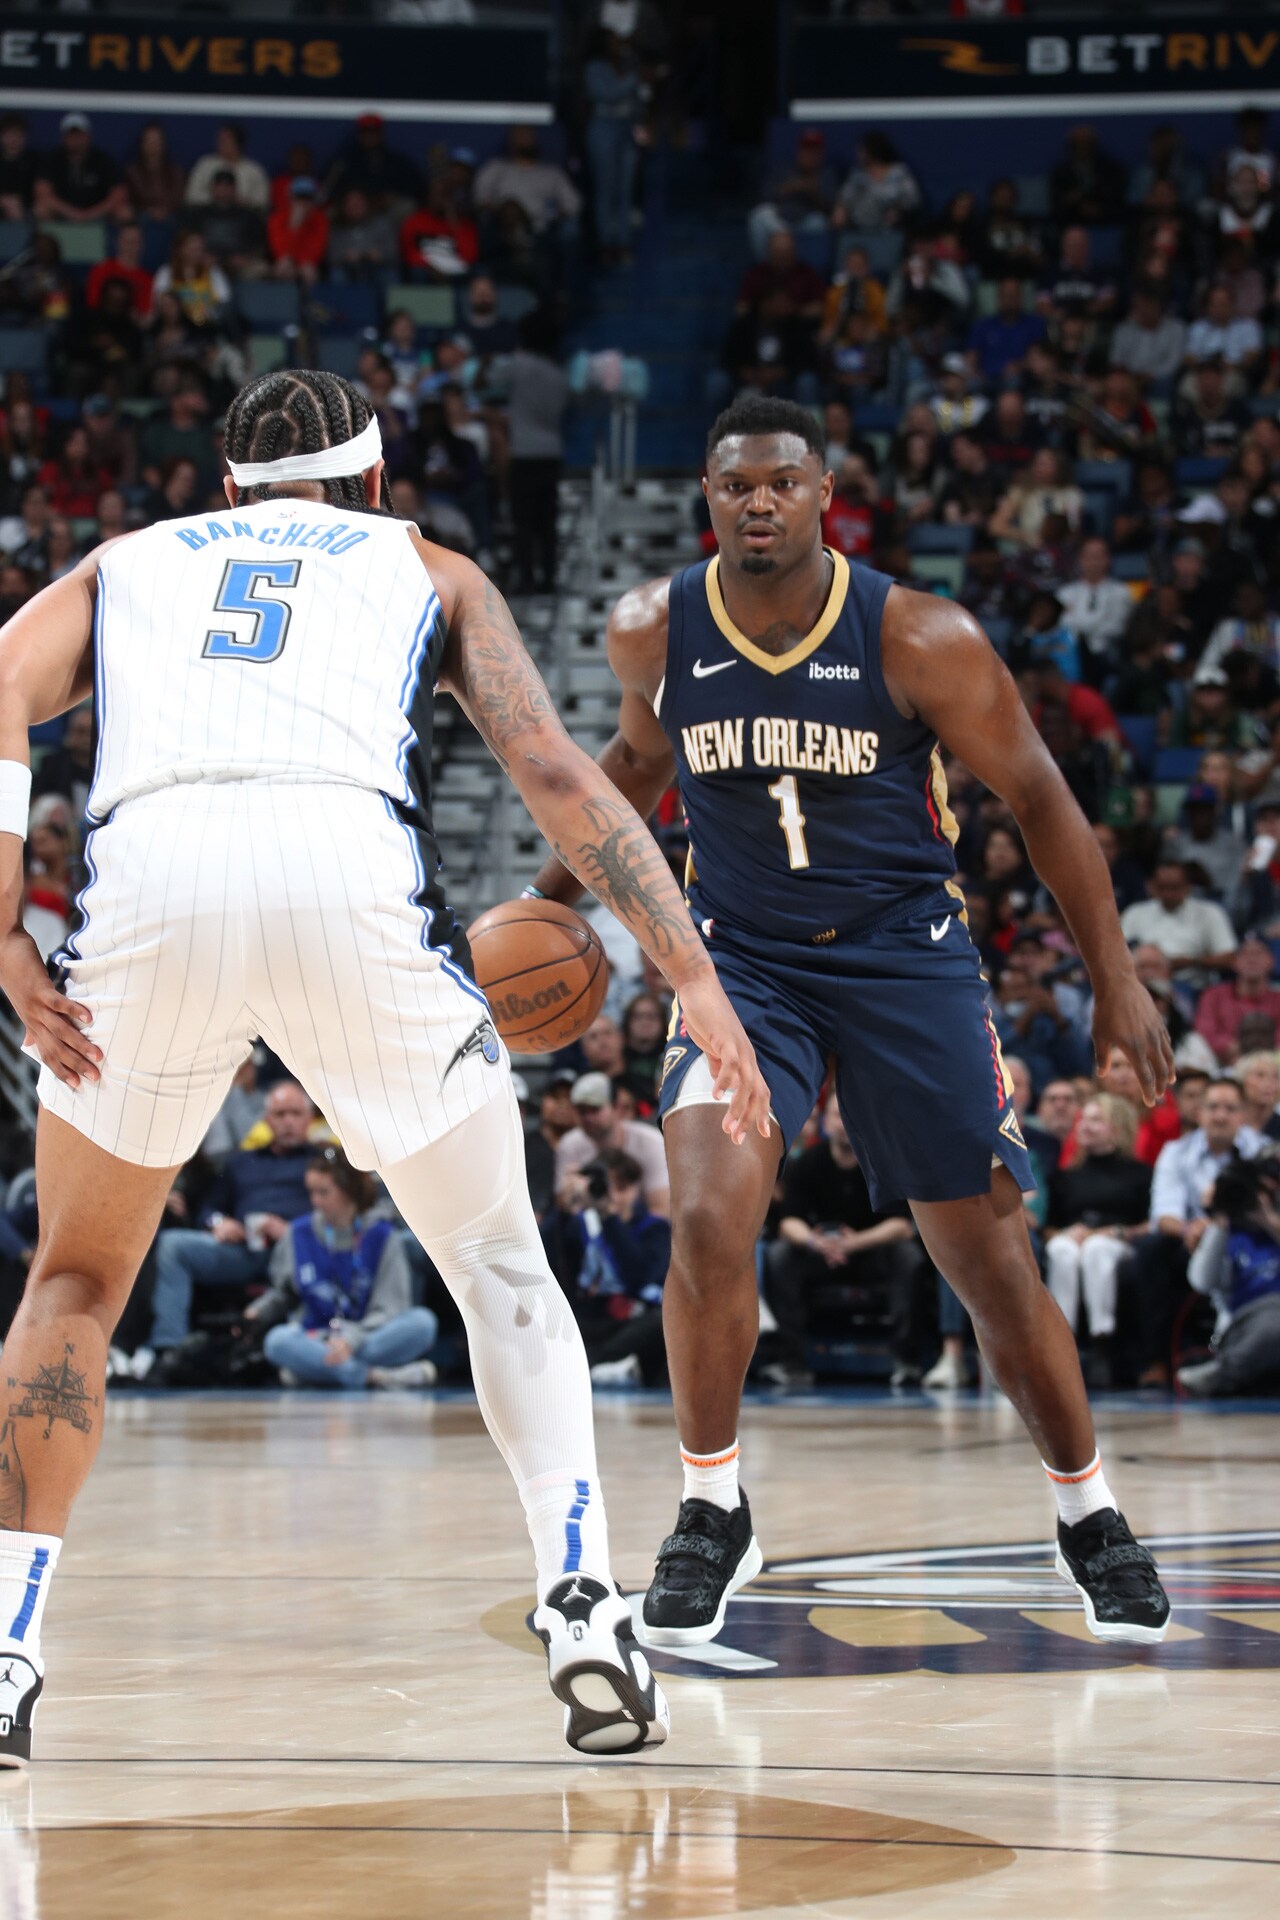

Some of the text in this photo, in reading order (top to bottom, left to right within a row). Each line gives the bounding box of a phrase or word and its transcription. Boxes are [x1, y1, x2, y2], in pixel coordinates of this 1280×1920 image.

[174, 520, 370, 556] BANCHERO
[200, 558, 303, 664] 5
[808, 662, 860, 681] ibotta
[680, 716, 879, 776] NEW ORLEANS
[767, 774, 810, 870] 1
[489, 979, 573, 1025] ilson
